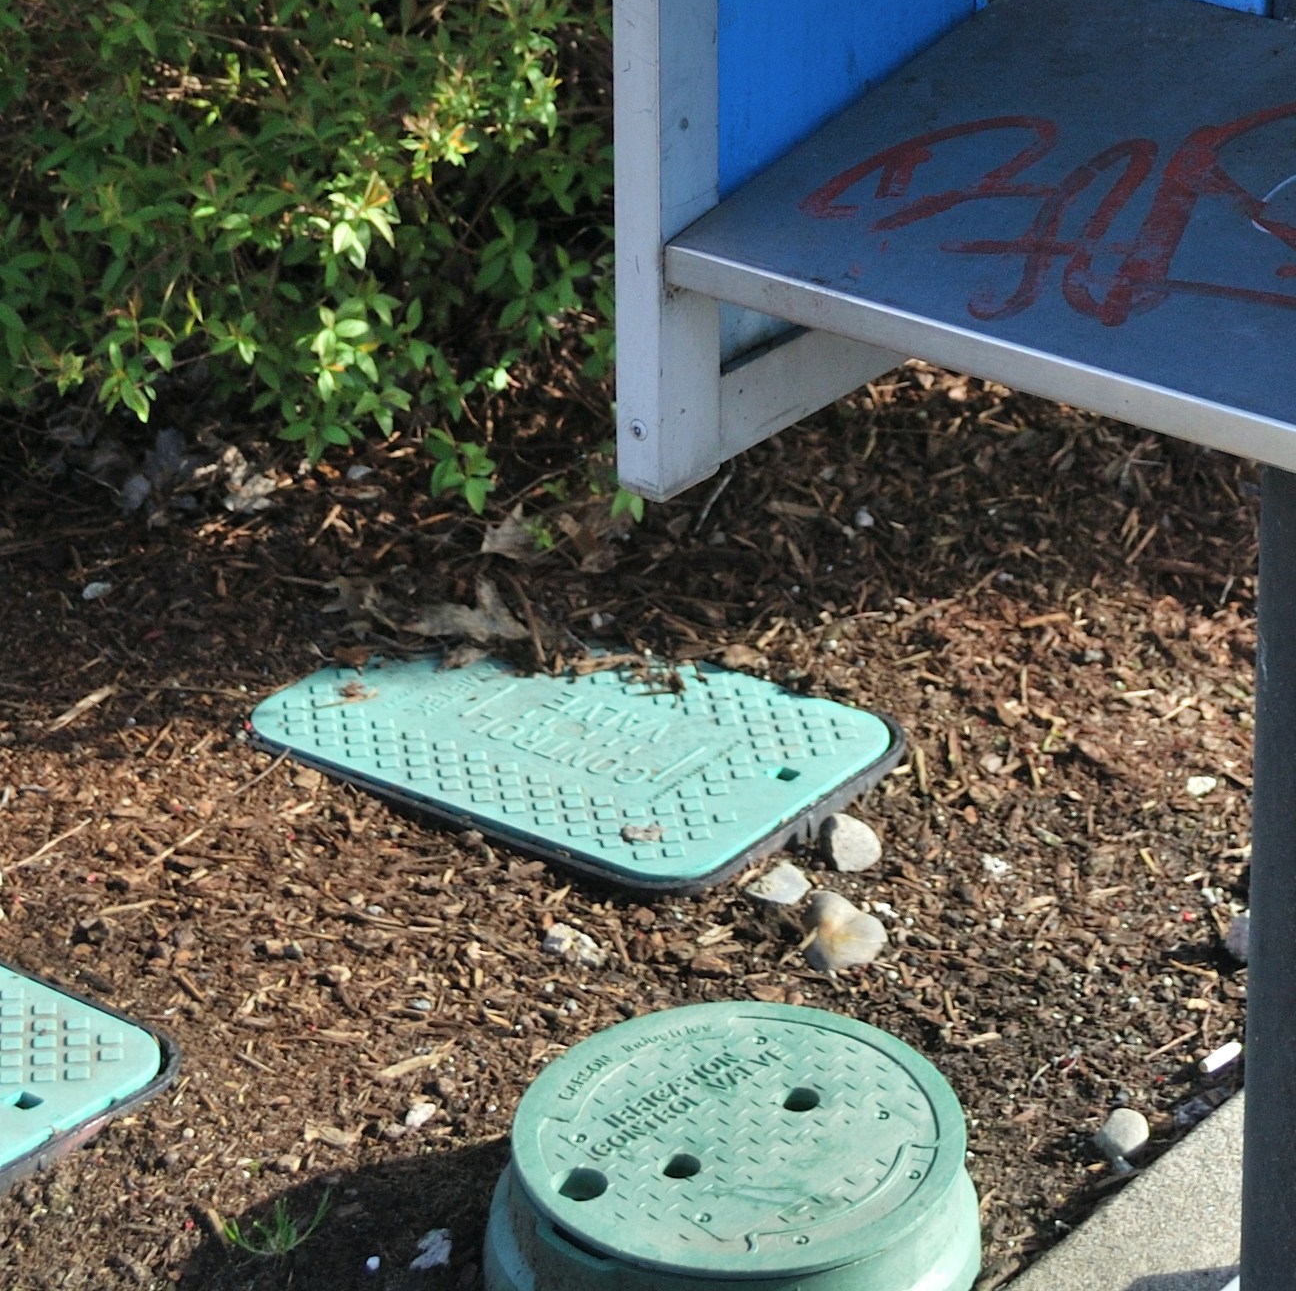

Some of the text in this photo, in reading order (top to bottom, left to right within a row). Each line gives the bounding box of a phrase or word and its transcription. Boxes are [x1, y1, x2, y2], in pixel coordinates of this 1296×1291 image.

[472, 714, 652, 785] CONTROL
[592, 1045, 786, 1160] CONTROL VALVE
[604, 1050, 740, 1128] IRRIGATION
